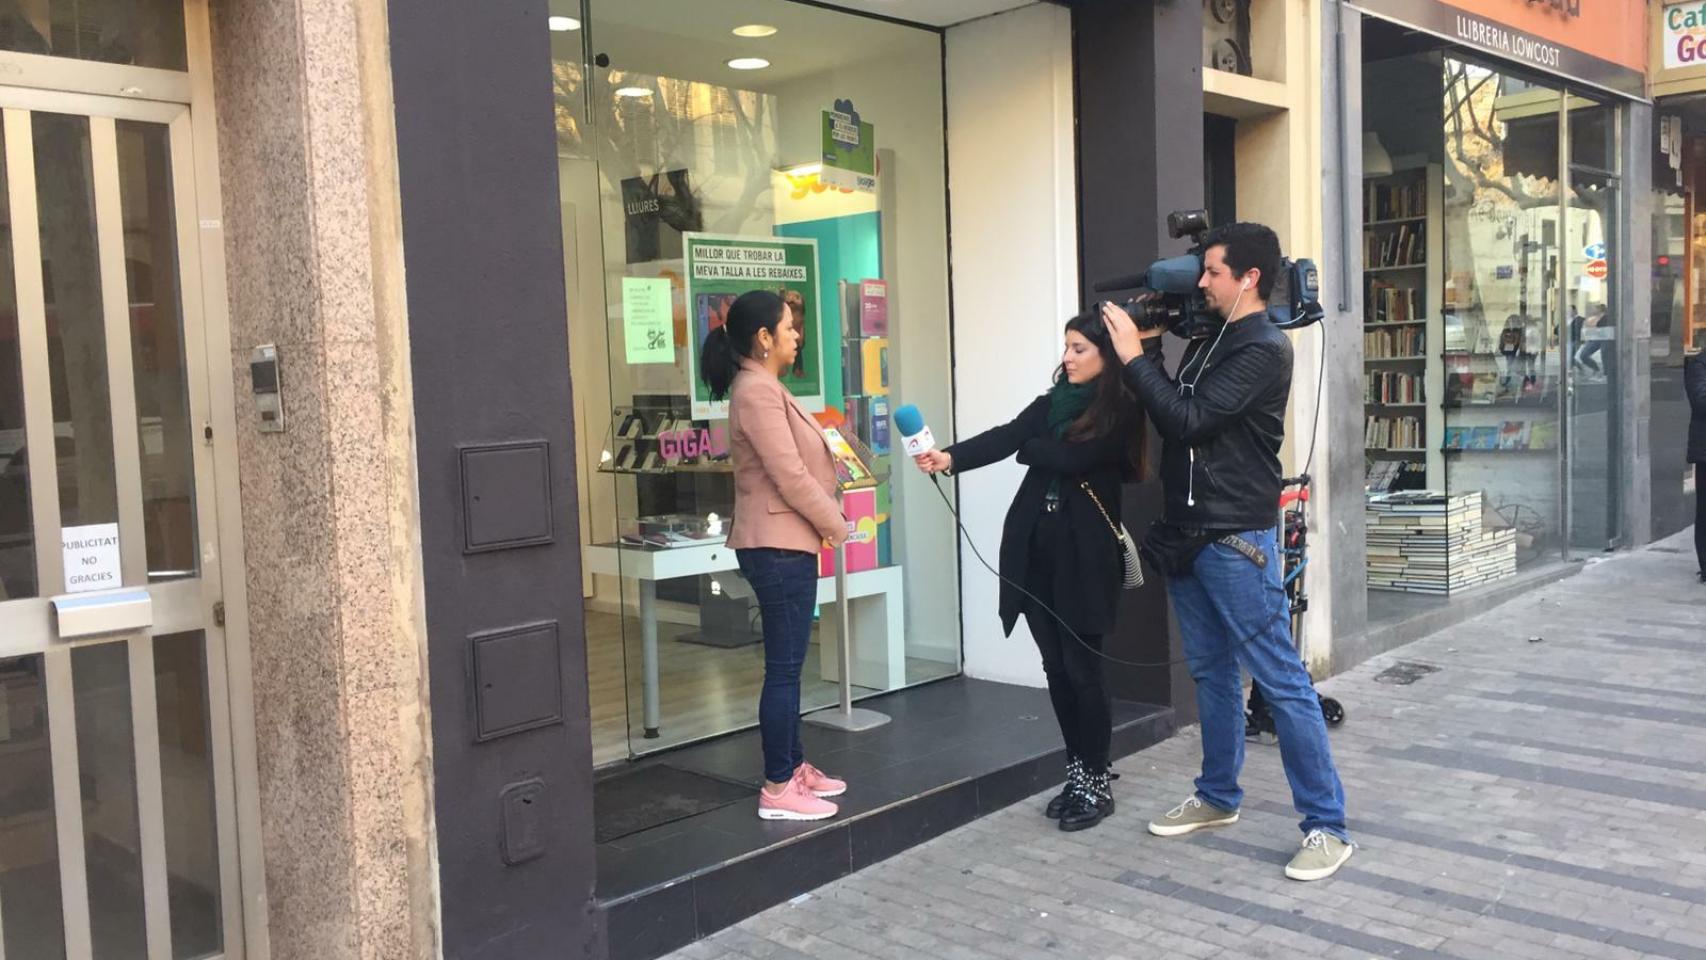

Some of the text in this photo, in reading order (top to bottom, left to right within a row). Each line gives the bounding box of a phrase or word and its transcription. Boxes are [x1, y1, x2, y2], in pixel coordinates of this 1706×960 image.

[1456, 15, 1560, 67] LLIBRERIA LOWCOST
[627, 199, 660, 216] LLIURES
[694, 247, 784, 262] MILLOR QUE TROBAR LA
[695, 265, 806, 280] MEVA TALLA A LES REBAIXES.
[81, 556, 98, 566] NO
[69, 571, 113, 585] GRACIES
